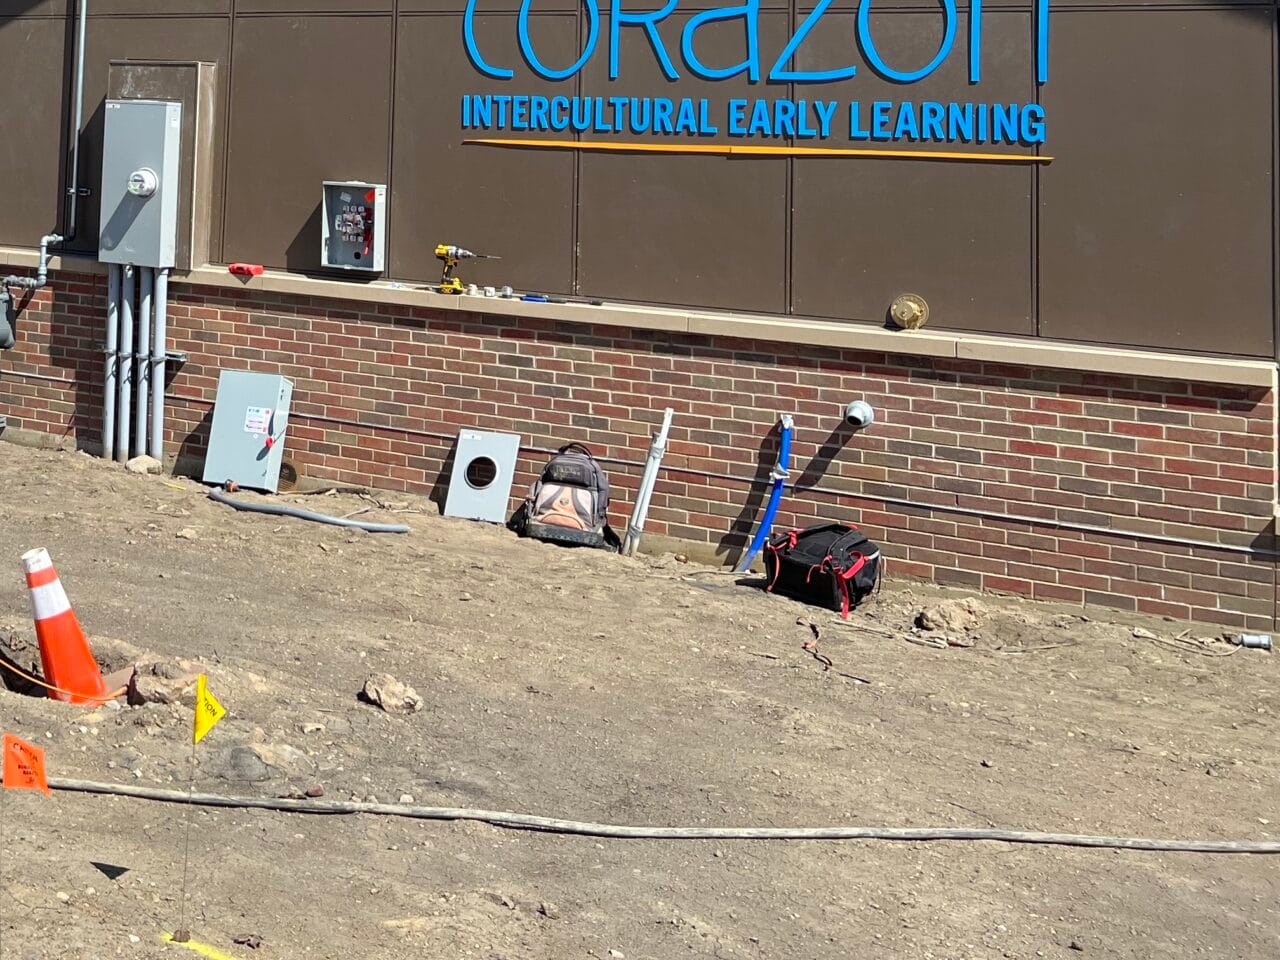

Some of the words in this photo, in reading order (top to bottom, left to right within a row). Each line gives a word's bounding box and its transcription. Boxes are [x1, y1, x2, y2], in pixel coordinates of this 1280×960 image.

[463, 95, 719, 134] INTERCULTURAL
[729, 98, 837, 137] EARLY
[850, 101, 1047, 144] LEARNING
